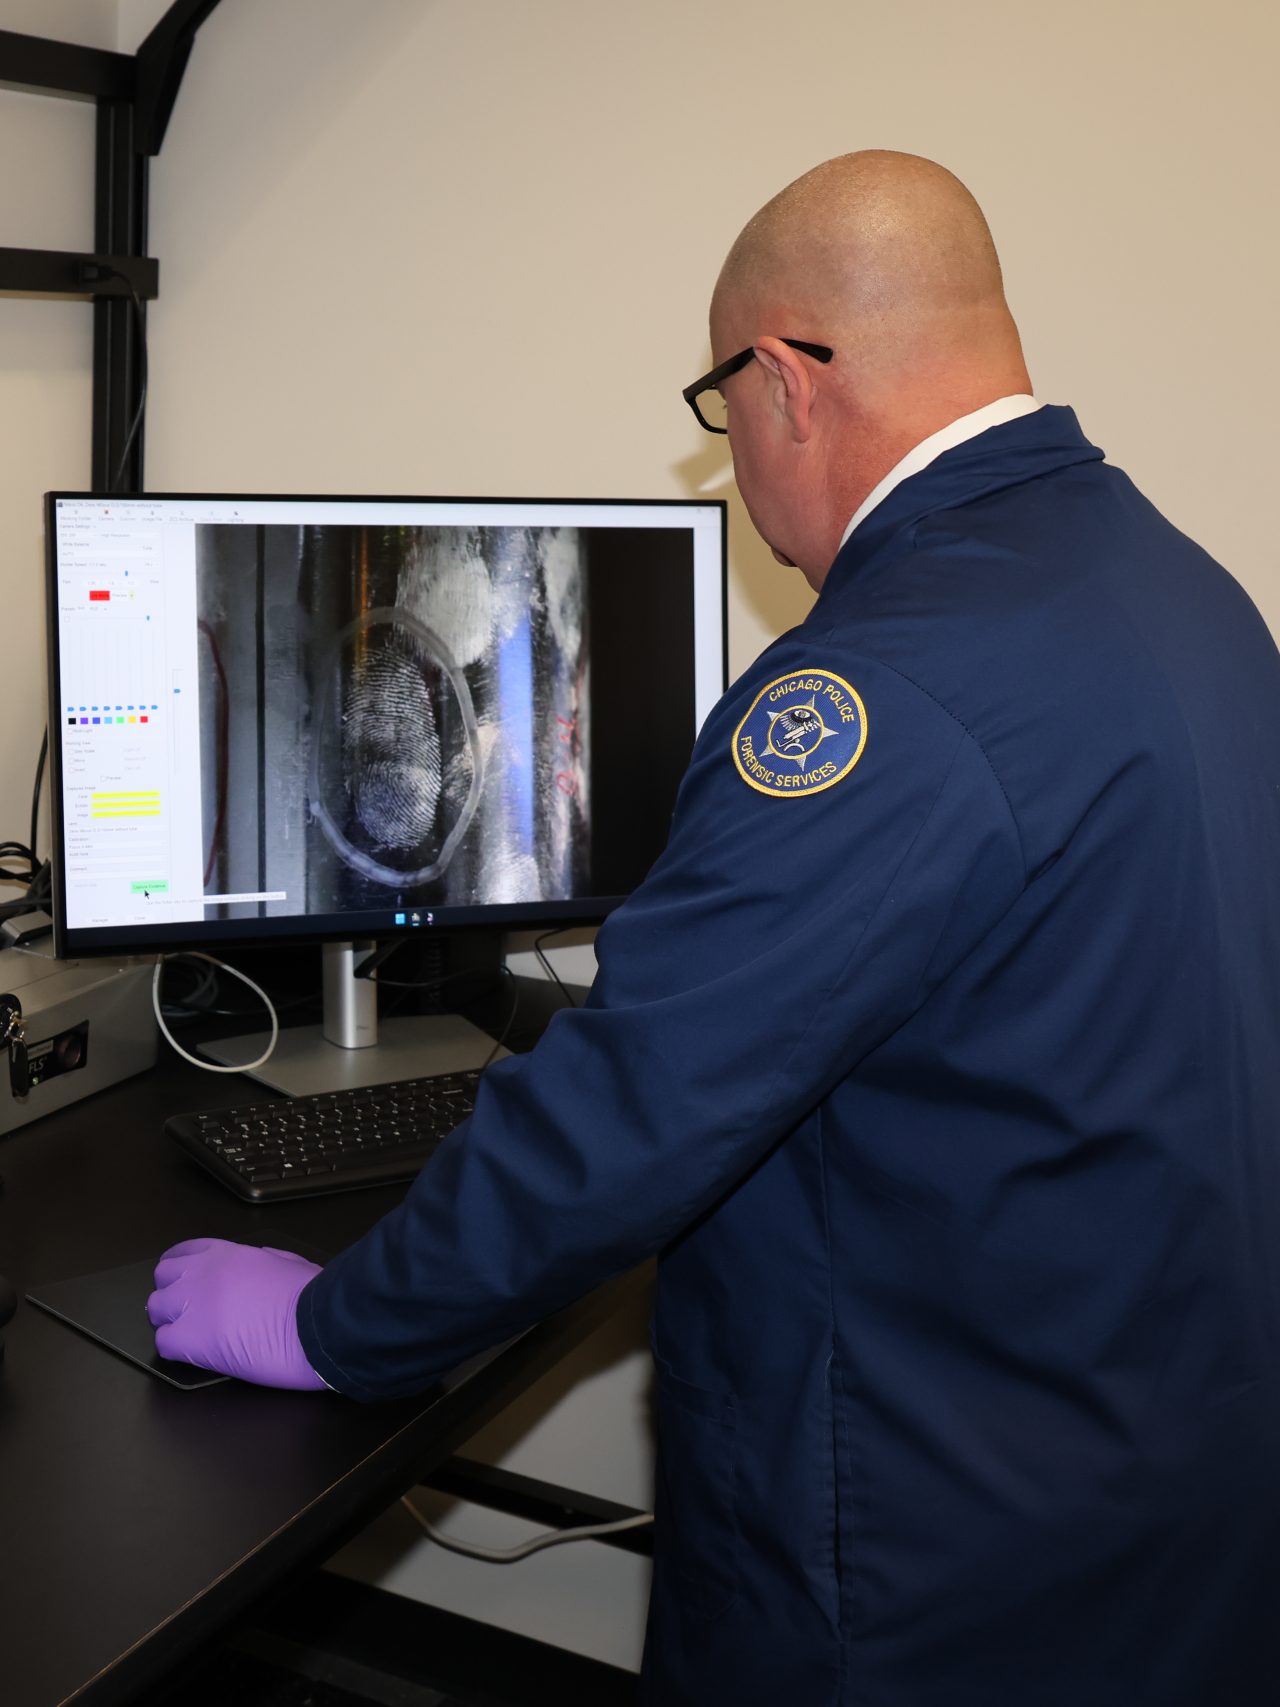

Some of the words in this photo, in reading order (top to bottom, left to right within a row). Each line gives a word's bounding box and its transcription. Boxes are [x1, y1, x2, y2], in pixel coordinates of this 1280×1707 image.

[768, 678, 822, 702] CHICAGO
[823, 684, 855, 723] POLICE
[740, 735, 776, 784] FORENSIC
[775, 761, 838, 788] SERVICES
